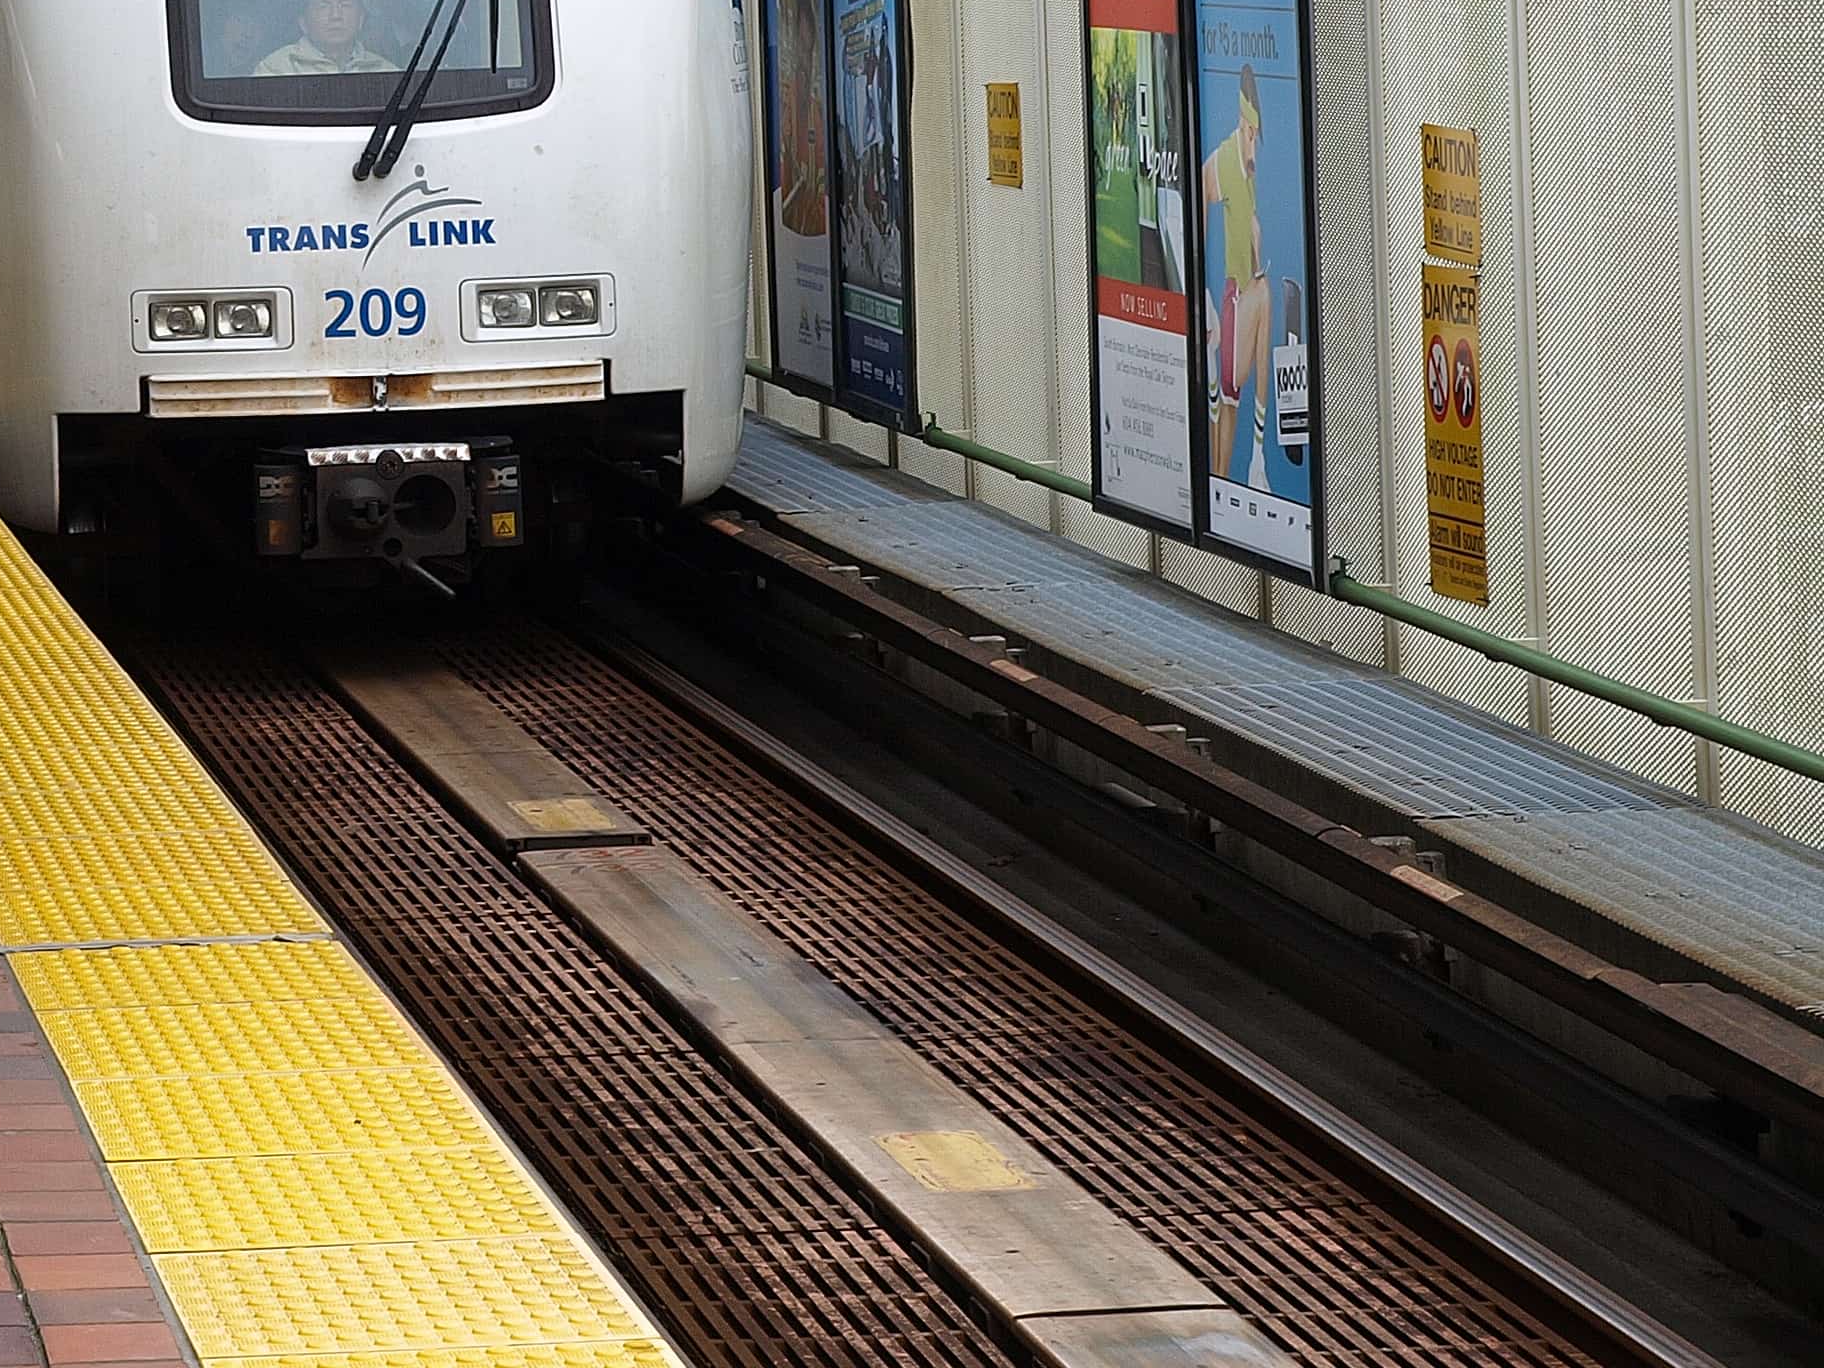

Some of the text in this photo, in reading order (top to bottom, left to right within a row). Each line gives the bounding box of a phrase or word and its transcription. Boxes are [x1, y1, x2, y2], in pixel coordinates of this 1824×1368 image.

[1202, 20, 1216, 54] for
[1424, 133, 1476, 178] CAUTION
[1426, 184, 1477, 218] Stand behind
[247, 218, 496, 253] TRANS LINK
[1429, 215, 1473, 249] Yellow Line
[324, 287, 427, 338] 209
[1424, 283, 1476, 325] DANGER
[1428, 438, 1478, 469] HIGH VOLTAGE
[1427, 474, 1482, 505] DO NOT ENTER
